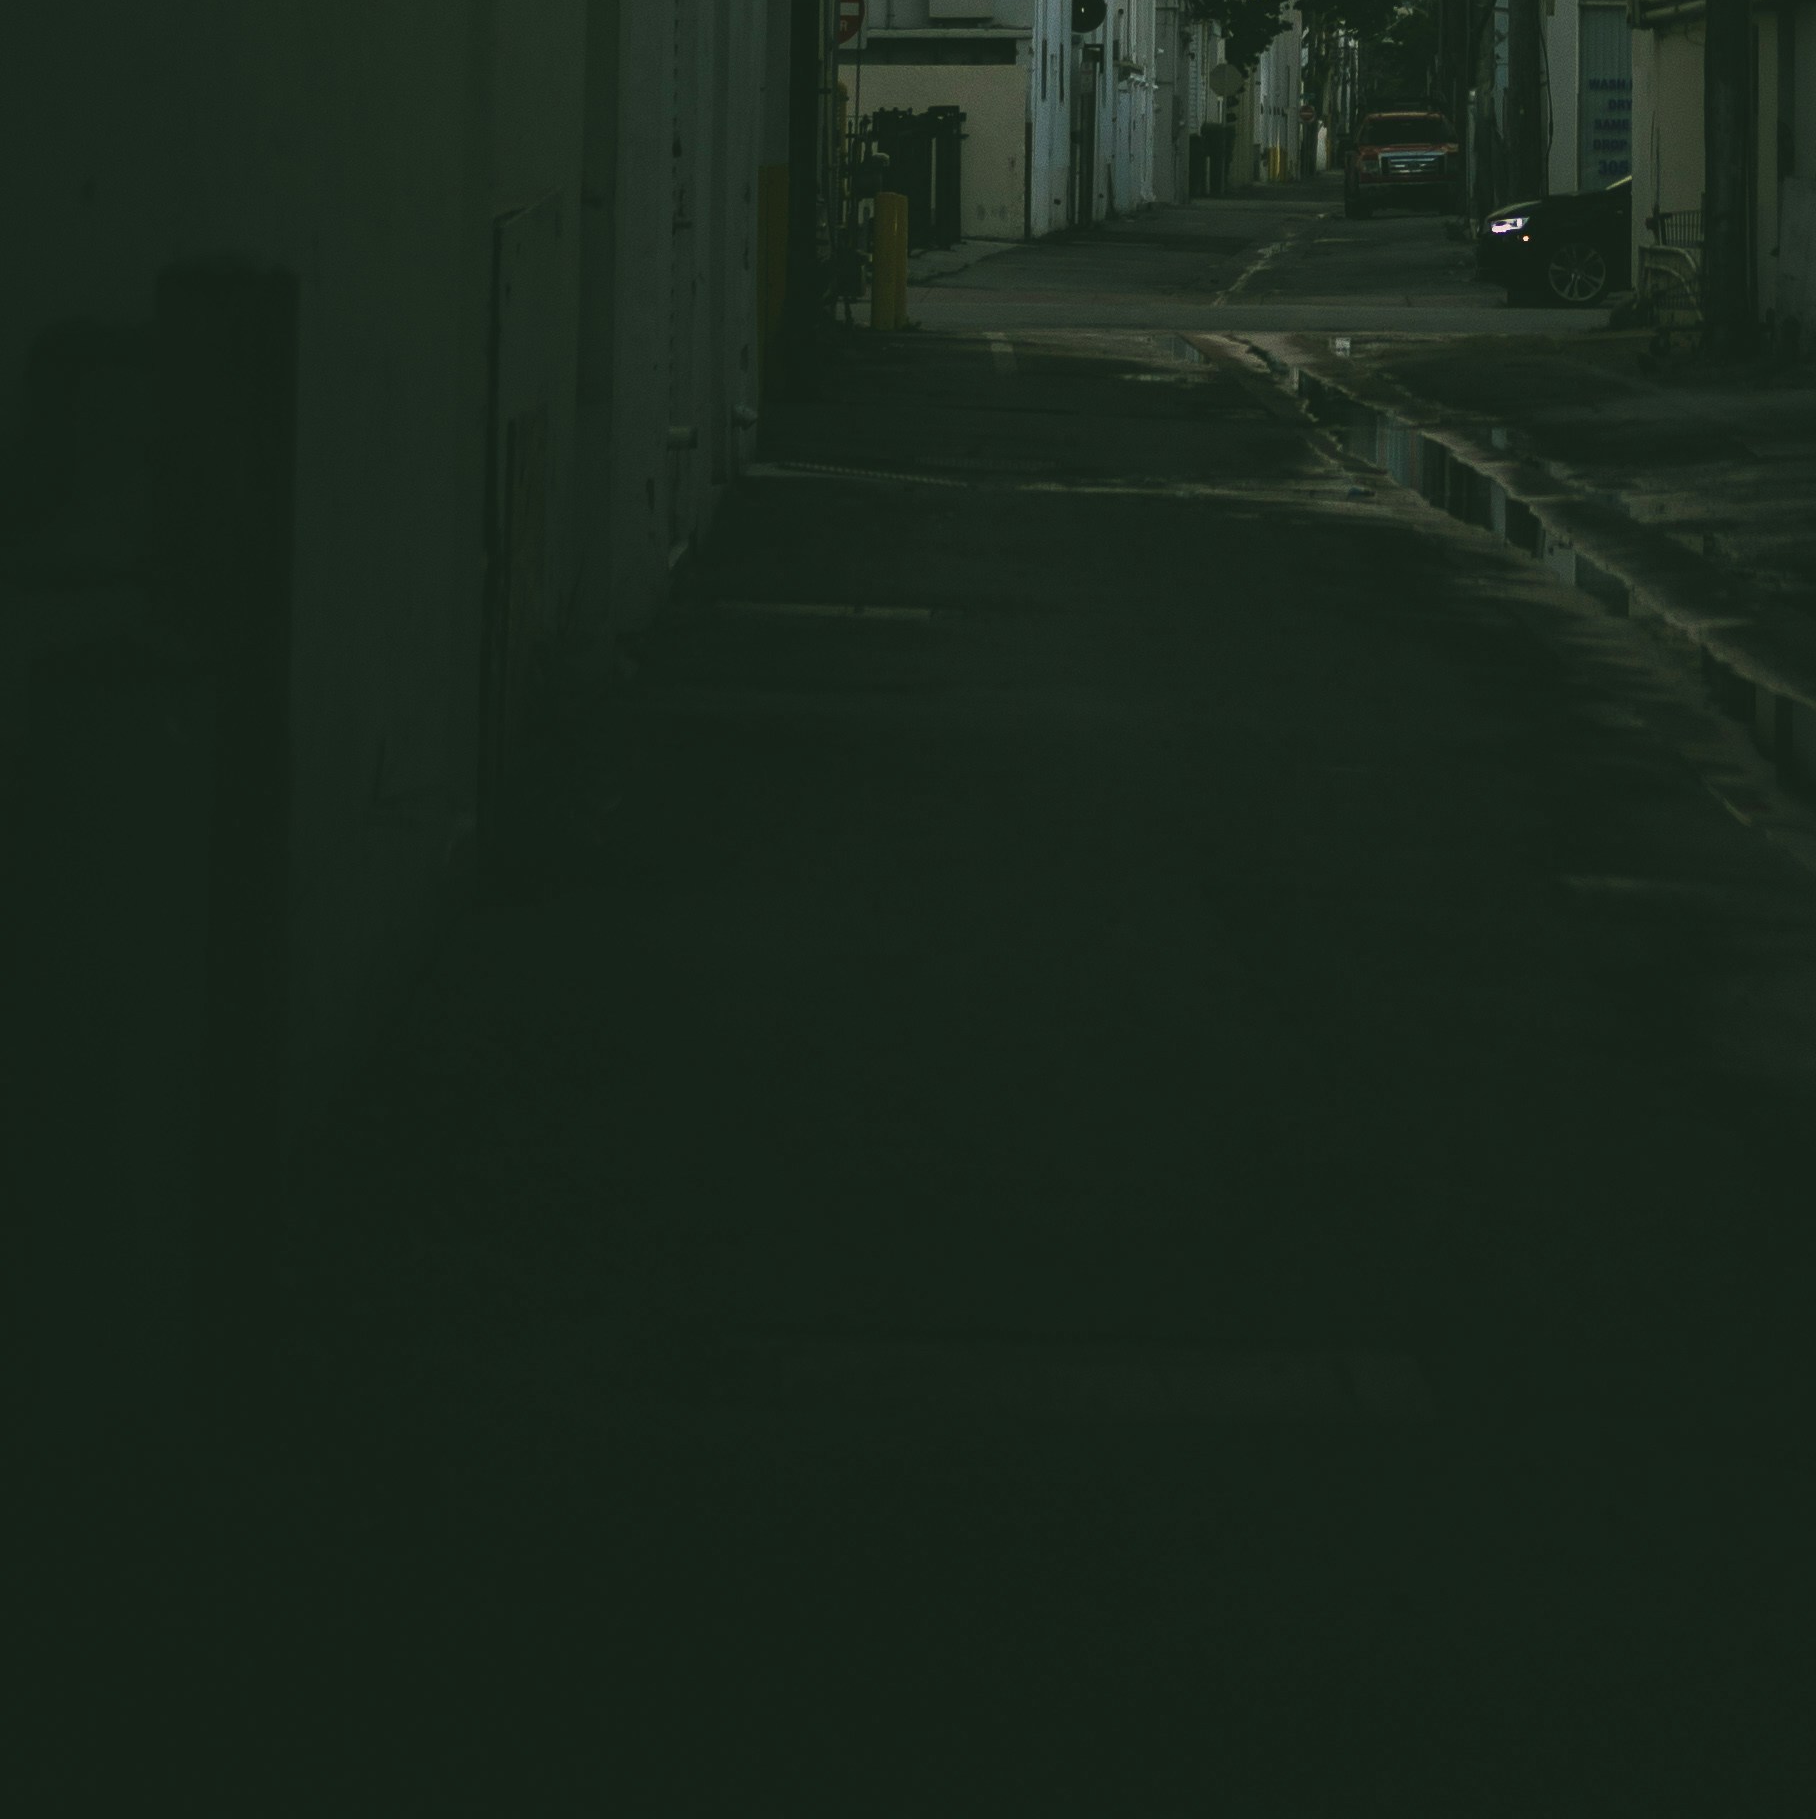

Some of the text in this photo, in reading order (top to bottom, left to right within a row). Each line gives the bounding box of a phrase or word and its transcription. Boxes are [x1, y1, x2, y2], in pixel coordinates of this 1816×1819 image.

[1589, 78, 1626, 90] WASH
[1608, 98, 1632, 111] DRY
[1593, 138, 1628, 151] DROP
[1598, 159, 1629, 175] 305
